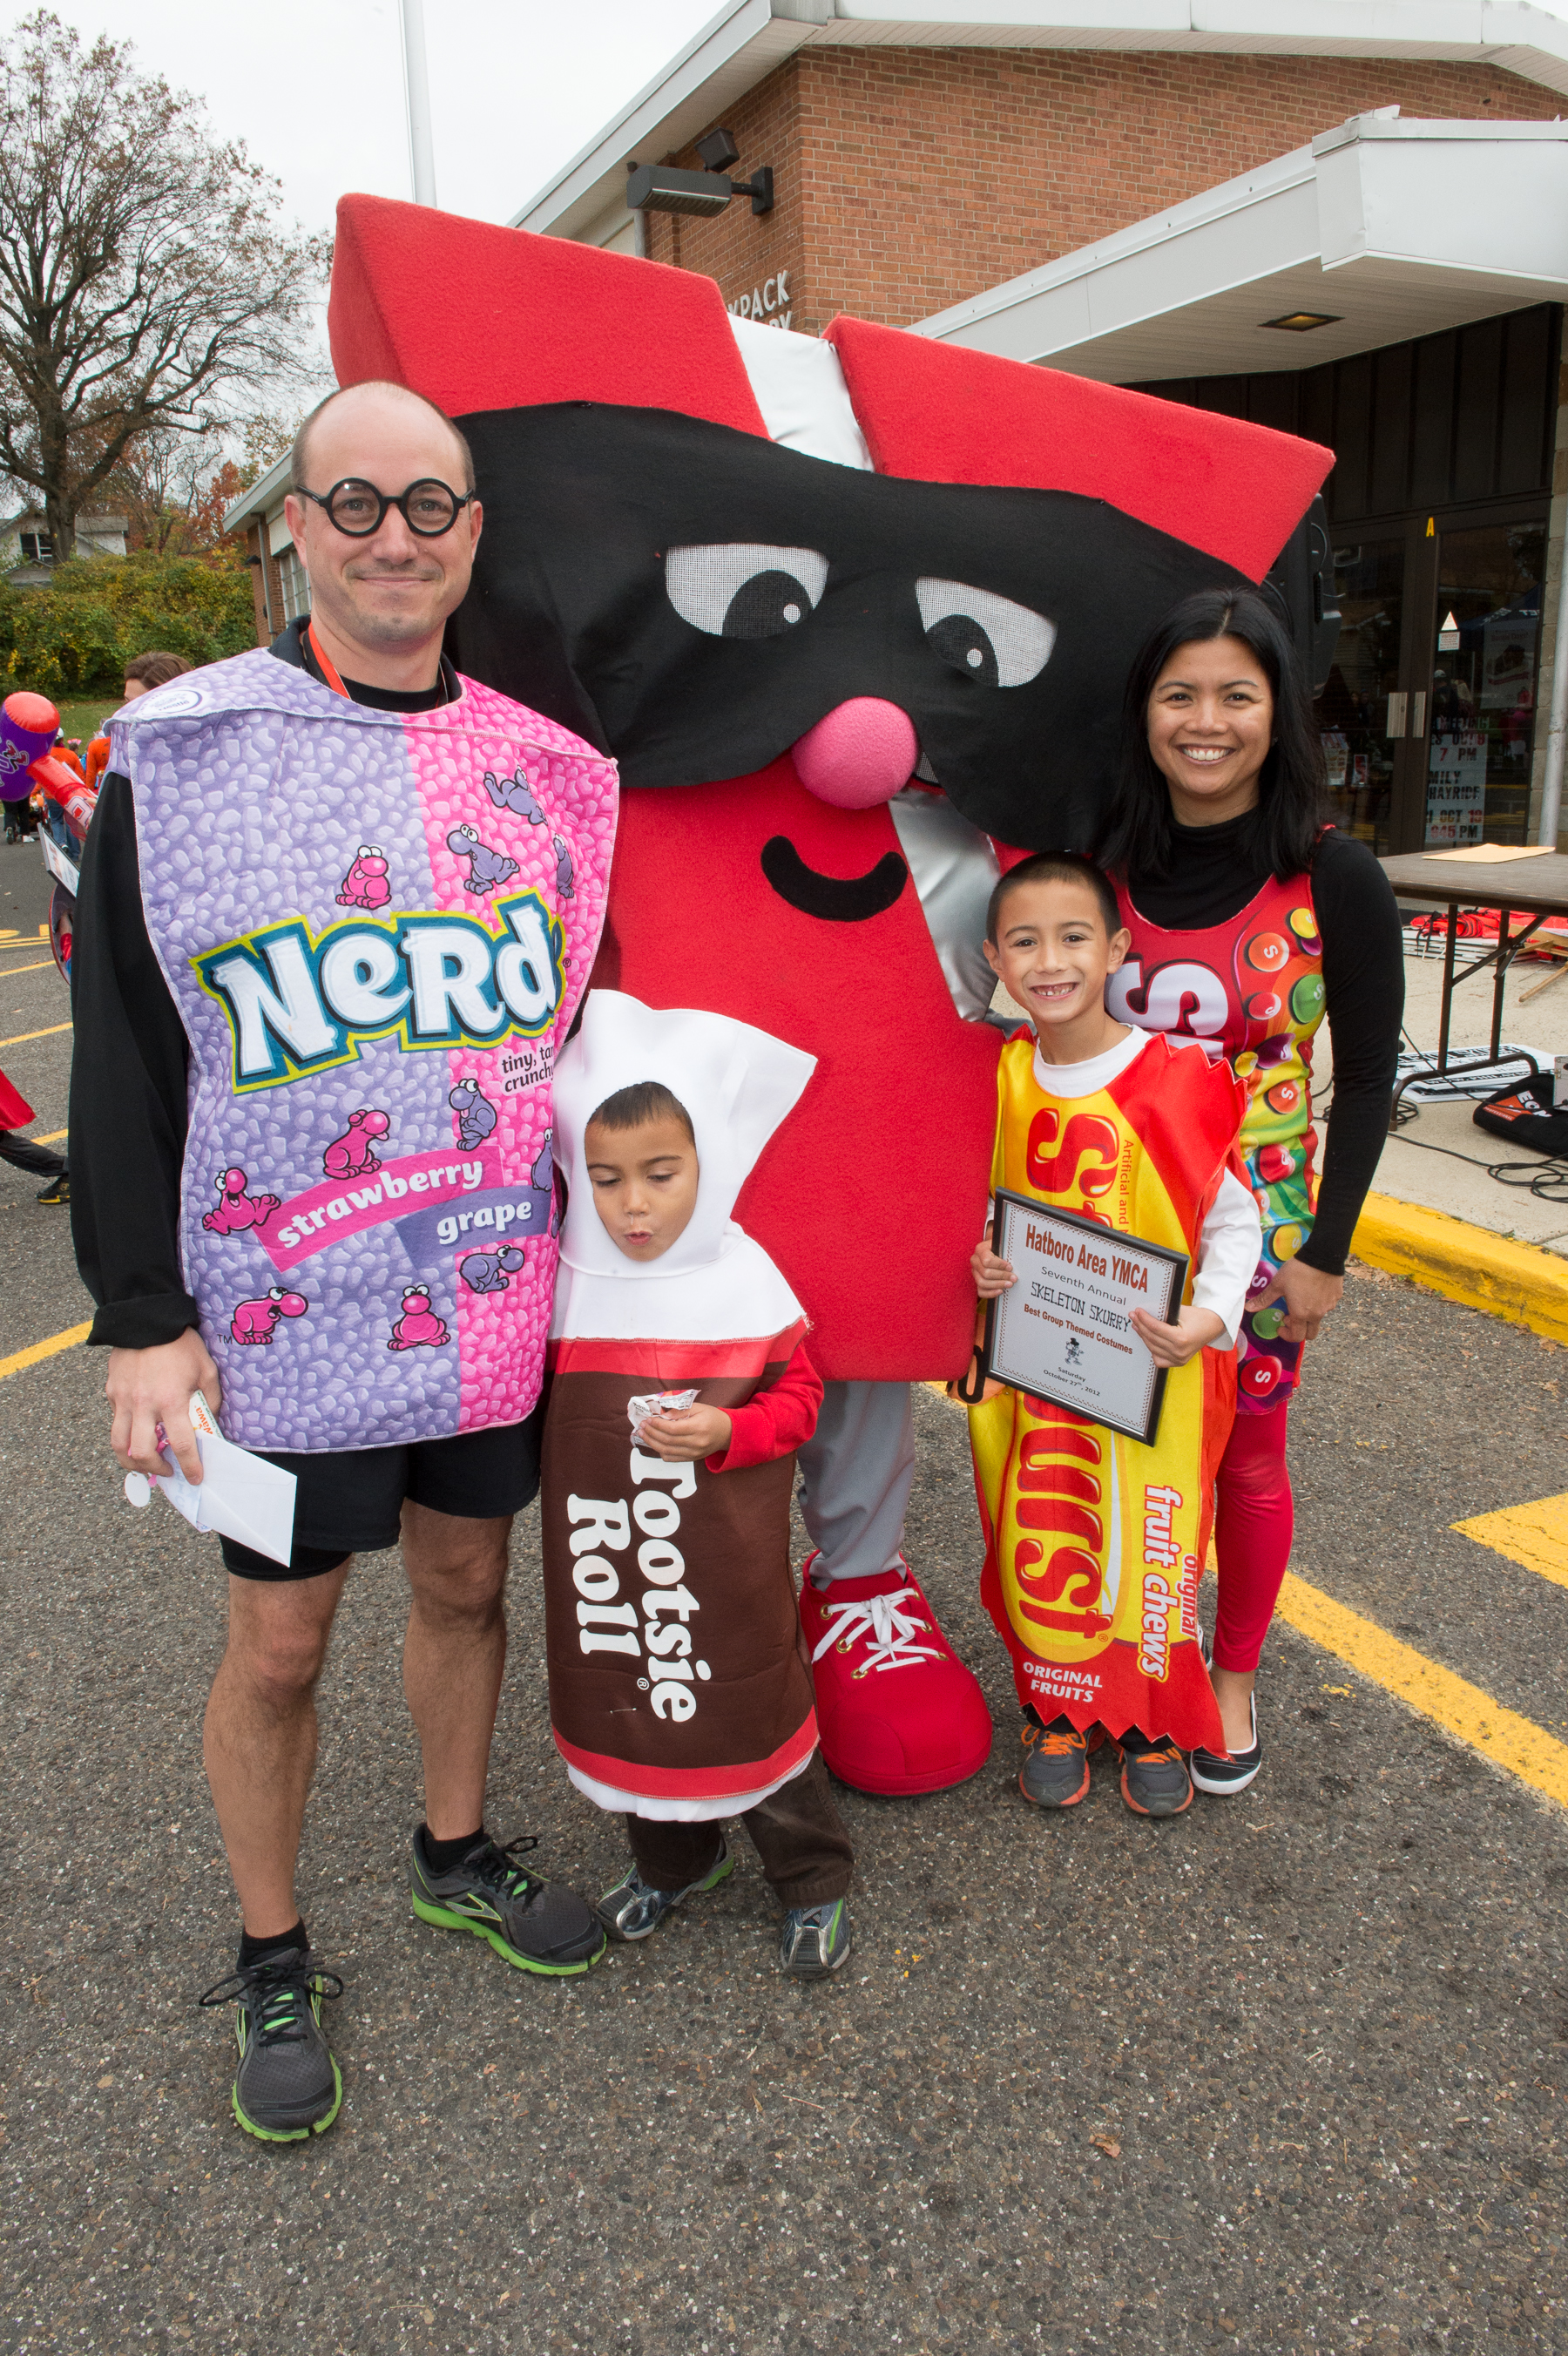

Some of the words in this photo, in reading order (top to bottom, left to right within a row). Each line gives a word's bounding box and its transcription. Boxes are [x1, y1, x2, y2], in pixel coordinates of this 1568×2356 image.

[1426, 517, 1435, 537] A
[1440, 748, 1448, 762] 7
[1440, 809, 1463, 823] OCT
[1459, 825, 1478, 838] PM
[502, 1053, 537, 1074] tiny,
[1119, 1139, 1134, 1195] Artificial
[277, 1161, 483, 1249] strawberry
[436, 1202, 532, 1246] grape
[1119, 1199, 1130, 1225] and
[1025, 1222, 1075, 1264] Hatboro
[1077, 1243, 1107, 1277] Area
[1112, 1255, 1148, 1293] YMCA
[1041, 1266, 1085, 1290] Seventh
[1087, 1284, 1126, 1306] Annual
[1031, 1281, 1086, 1316] SKELETON
[1089, 1303, 1132, 1333] SKURRY
[1024, 1303, 1041, 1318] Best
[1042, 1310, 1064, 1328] Group
[1065, 1319, 1096, 1340] Themed
[1096, 1332, 1133, 1355] Costumes
[1043, 1369, 1069, 1384] October
[1085, 1386, 1101, 1398] 2012
[1058, 1366, 1087, 1383] Saturday
[1144, 1485, 1183, 1569] fruit
[567, 1493, 641, 1656] Roll
[630, 1446, 712, 1723] Tootsie
[1139, 1574, 1179, 1680] chews
[1023, 1662, 1103, 1688] ORIGINAL
[1031, 1679, 1094, 1703] FRUITS
